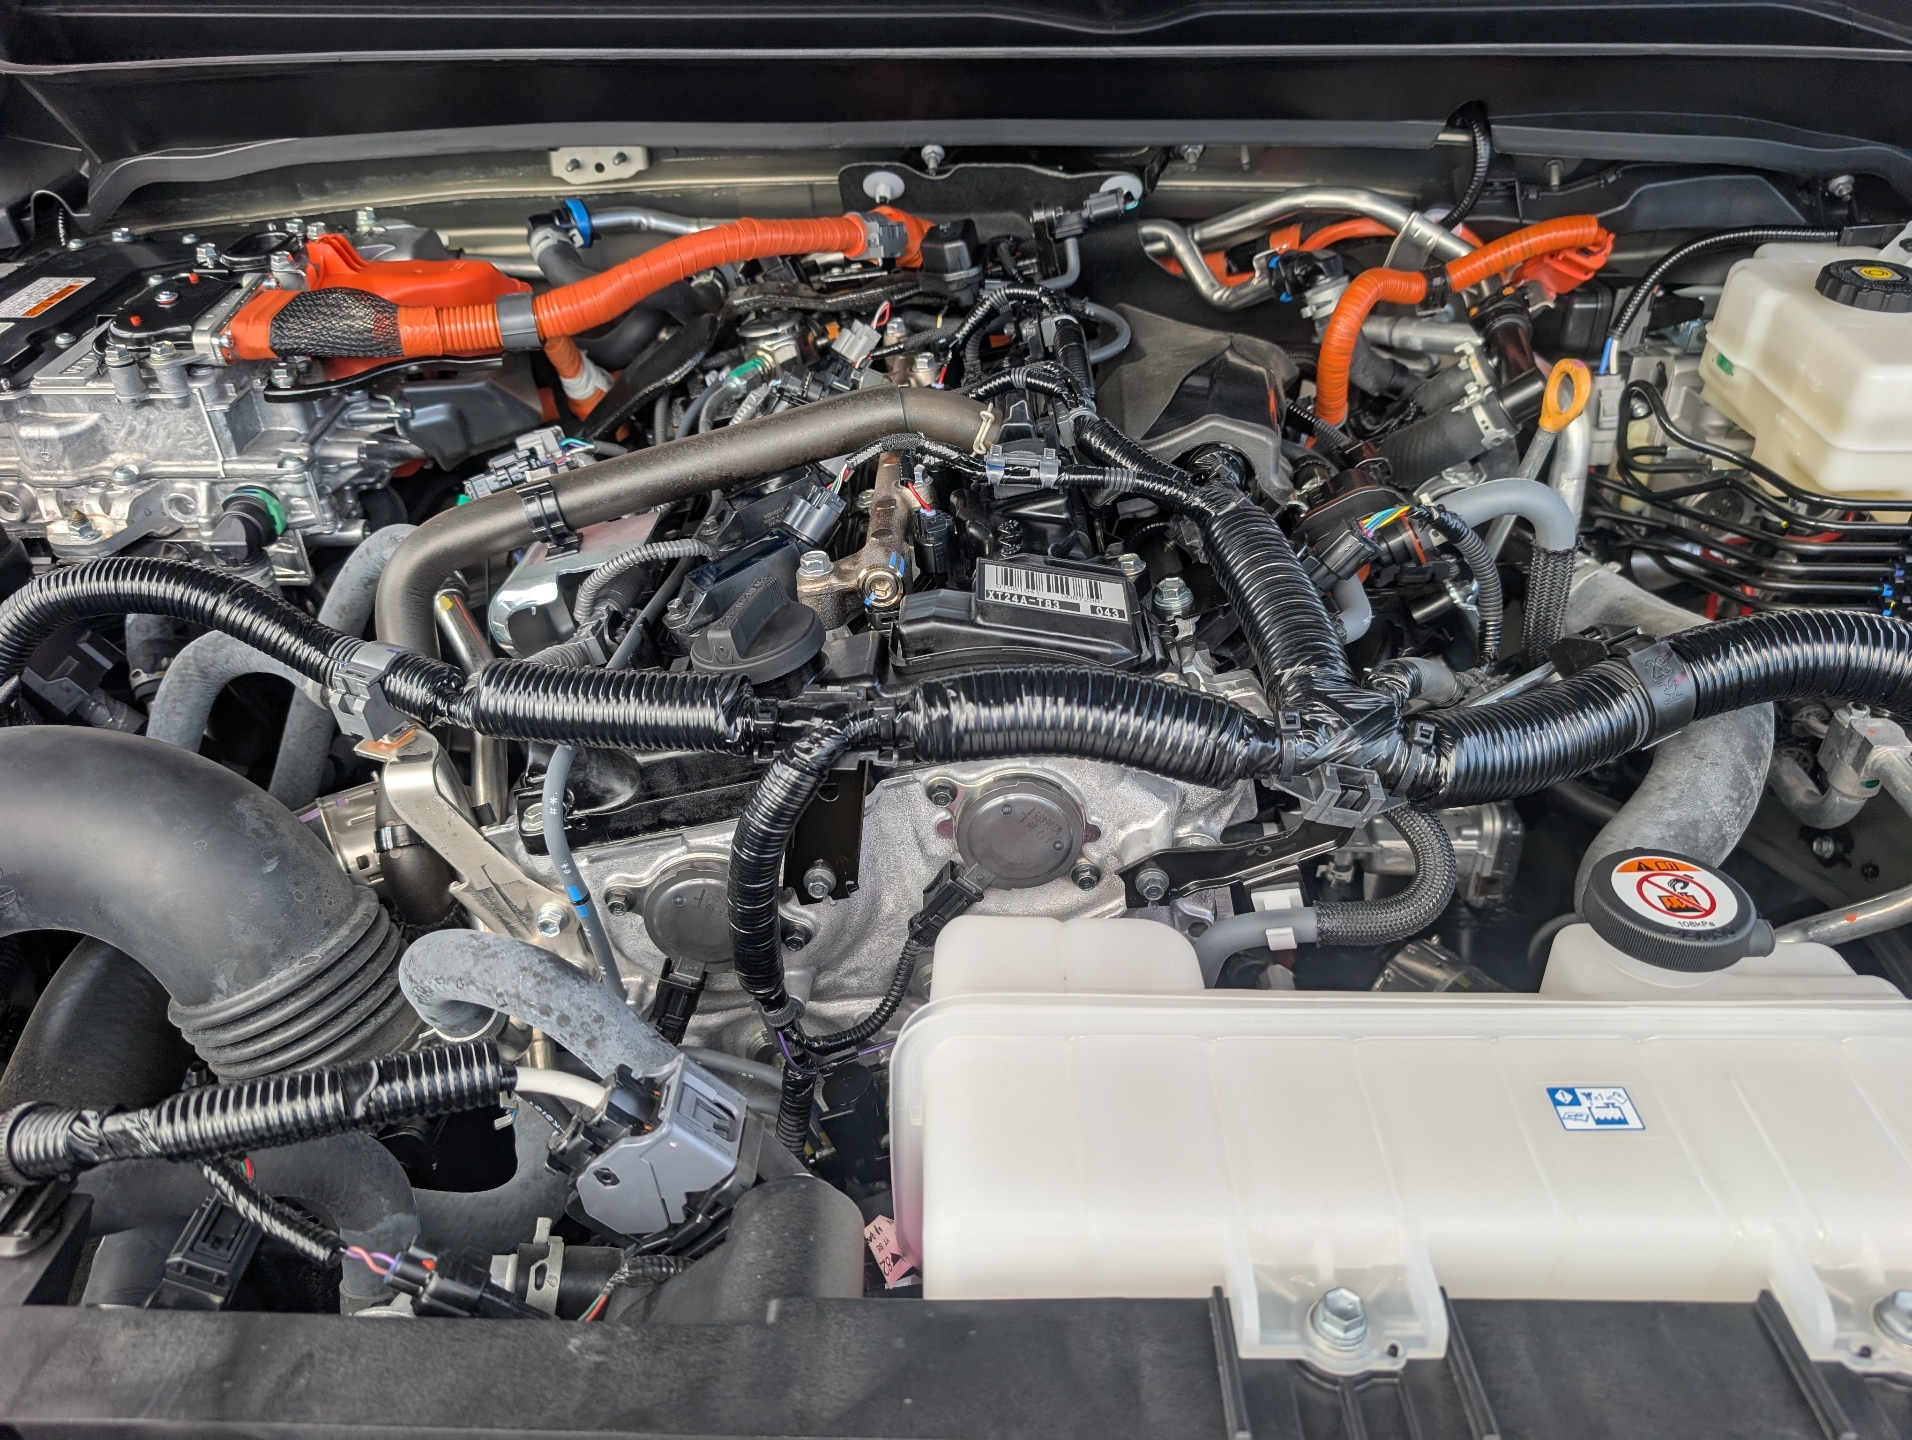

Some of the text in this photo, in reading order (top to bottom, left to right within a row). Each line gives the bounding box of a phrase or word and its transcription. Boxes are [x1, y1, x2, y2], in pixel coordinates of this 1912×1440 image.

[988, 590, 1120, 619] XT24A-T83 043
[1645, 655, 1673, 681] 28
[1657, 676, 1684, 706] 32
[1677, 920, 1716, 928] 108kPa
[879, 1256, 893, 1277] 82
